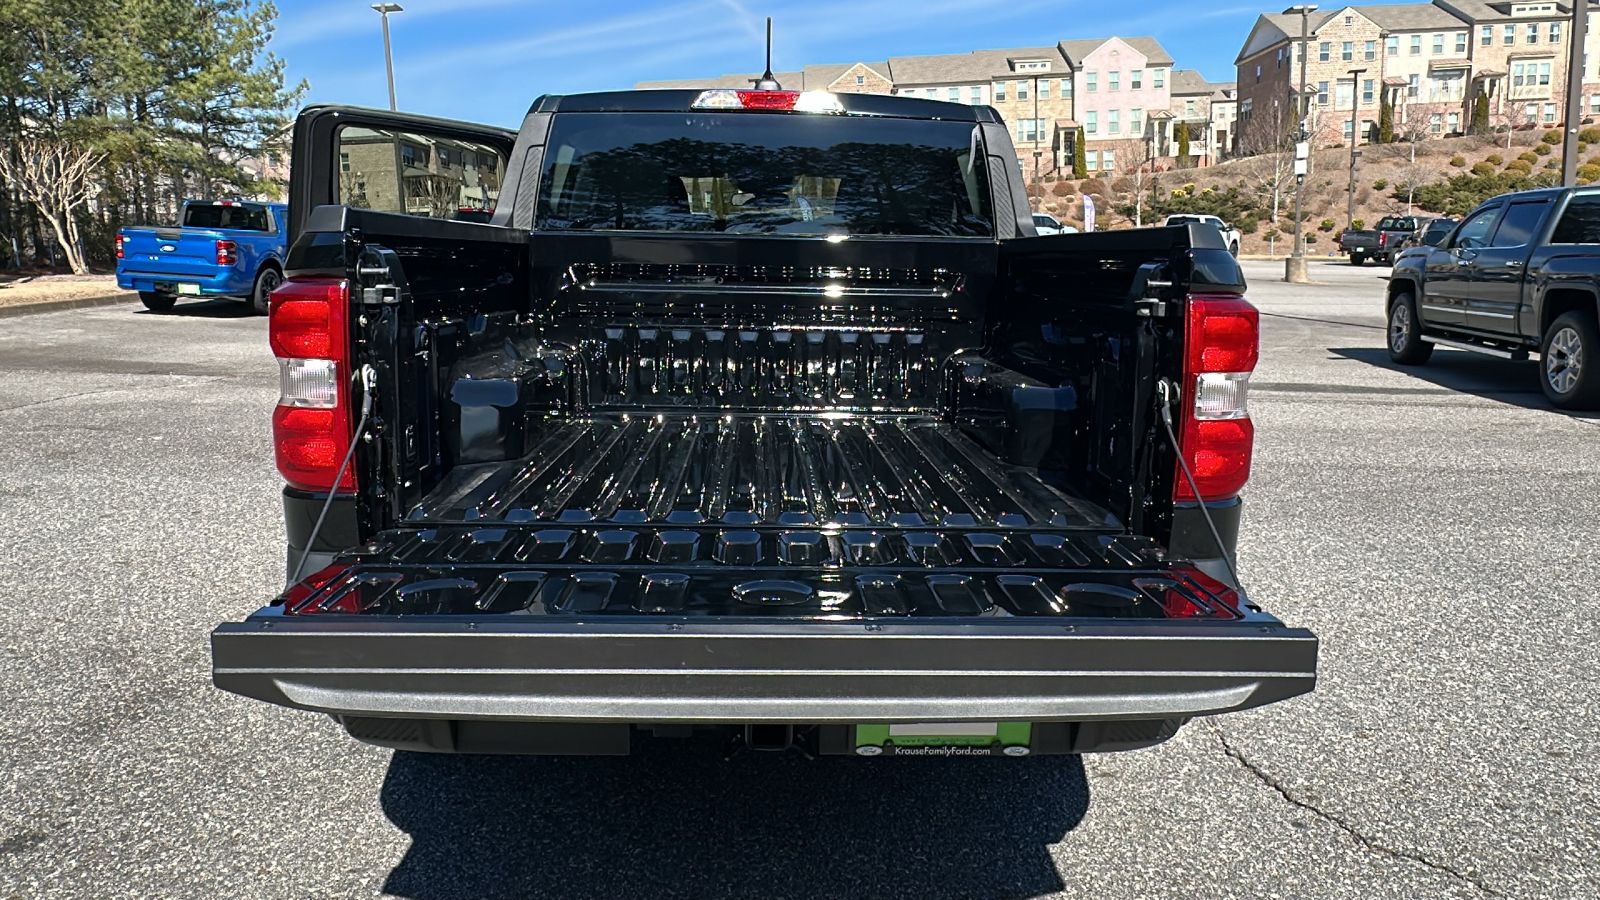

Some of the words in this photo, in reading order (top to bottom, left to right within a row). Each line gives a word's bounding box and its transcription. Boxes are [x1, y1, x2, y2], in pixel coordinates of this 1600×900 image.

[860, 747, 877, 755] Ford
[895, 746, 991, 757] KrauseFamilyFord.com
[1008, 747, 1025, 755] Ford
